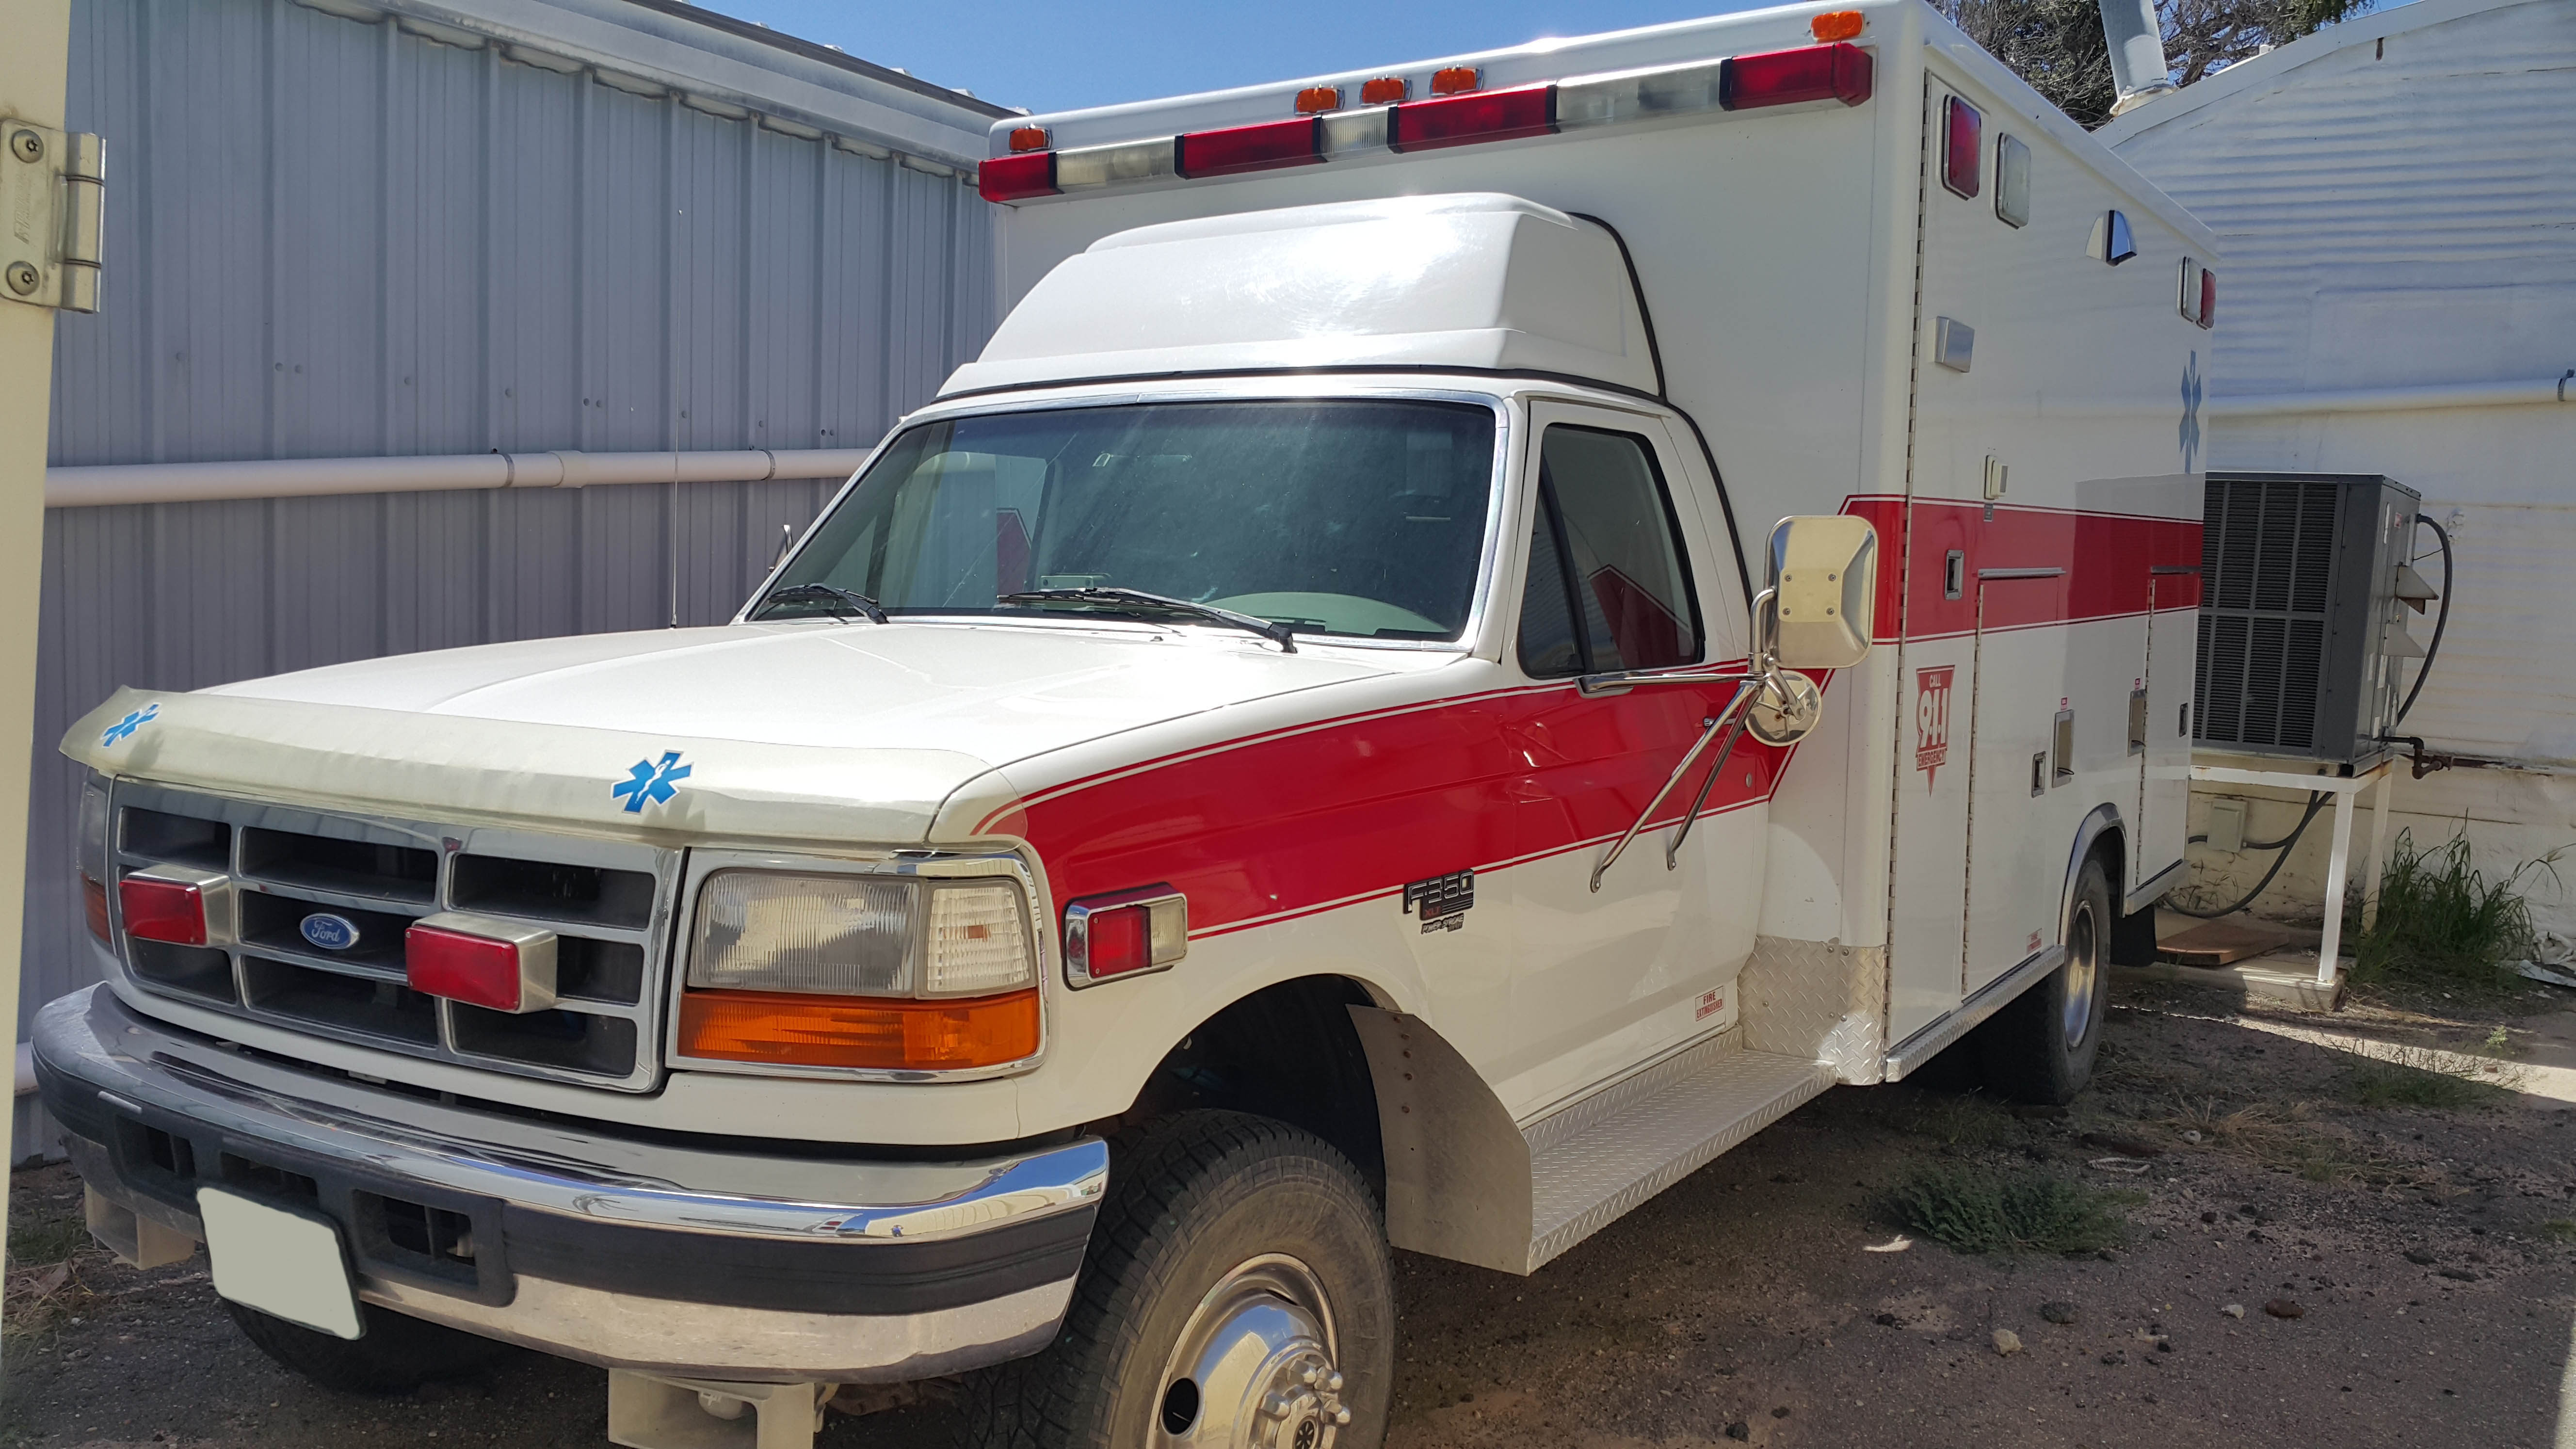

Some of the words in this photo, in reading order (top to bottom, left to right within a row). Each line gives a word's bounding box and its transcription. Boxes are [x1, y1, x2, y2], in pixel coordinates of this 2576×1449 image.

[1930, 674, 1941, 688] CALL
[1918, 750, 1945, 767] EMERGENCY
[311, 920, 340, 942] Ford
[1704, 992, 1716, 1005] FIRE
[1697, 998, 1722, 1018] EXTINGUISHER
